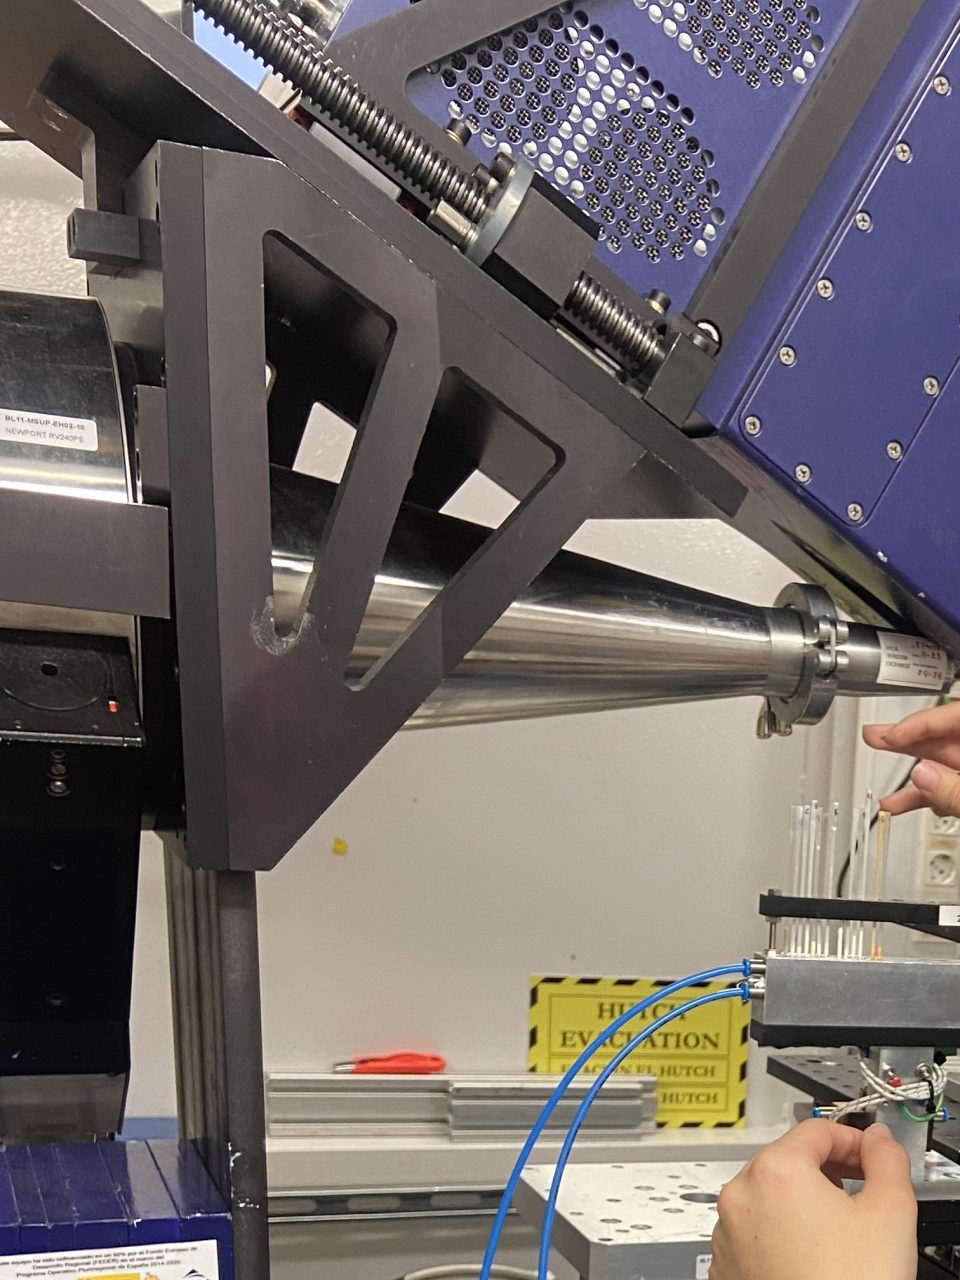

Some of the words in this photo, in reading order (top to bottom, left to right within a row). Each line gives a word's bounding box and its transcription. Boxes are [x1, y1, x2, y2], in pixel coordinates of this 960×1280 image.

[6, 428, 47, 438] NEWPORT
[659, 1065, 716, 1078] HUTCH
[661, 1092, 719, 1105] HUTCH
